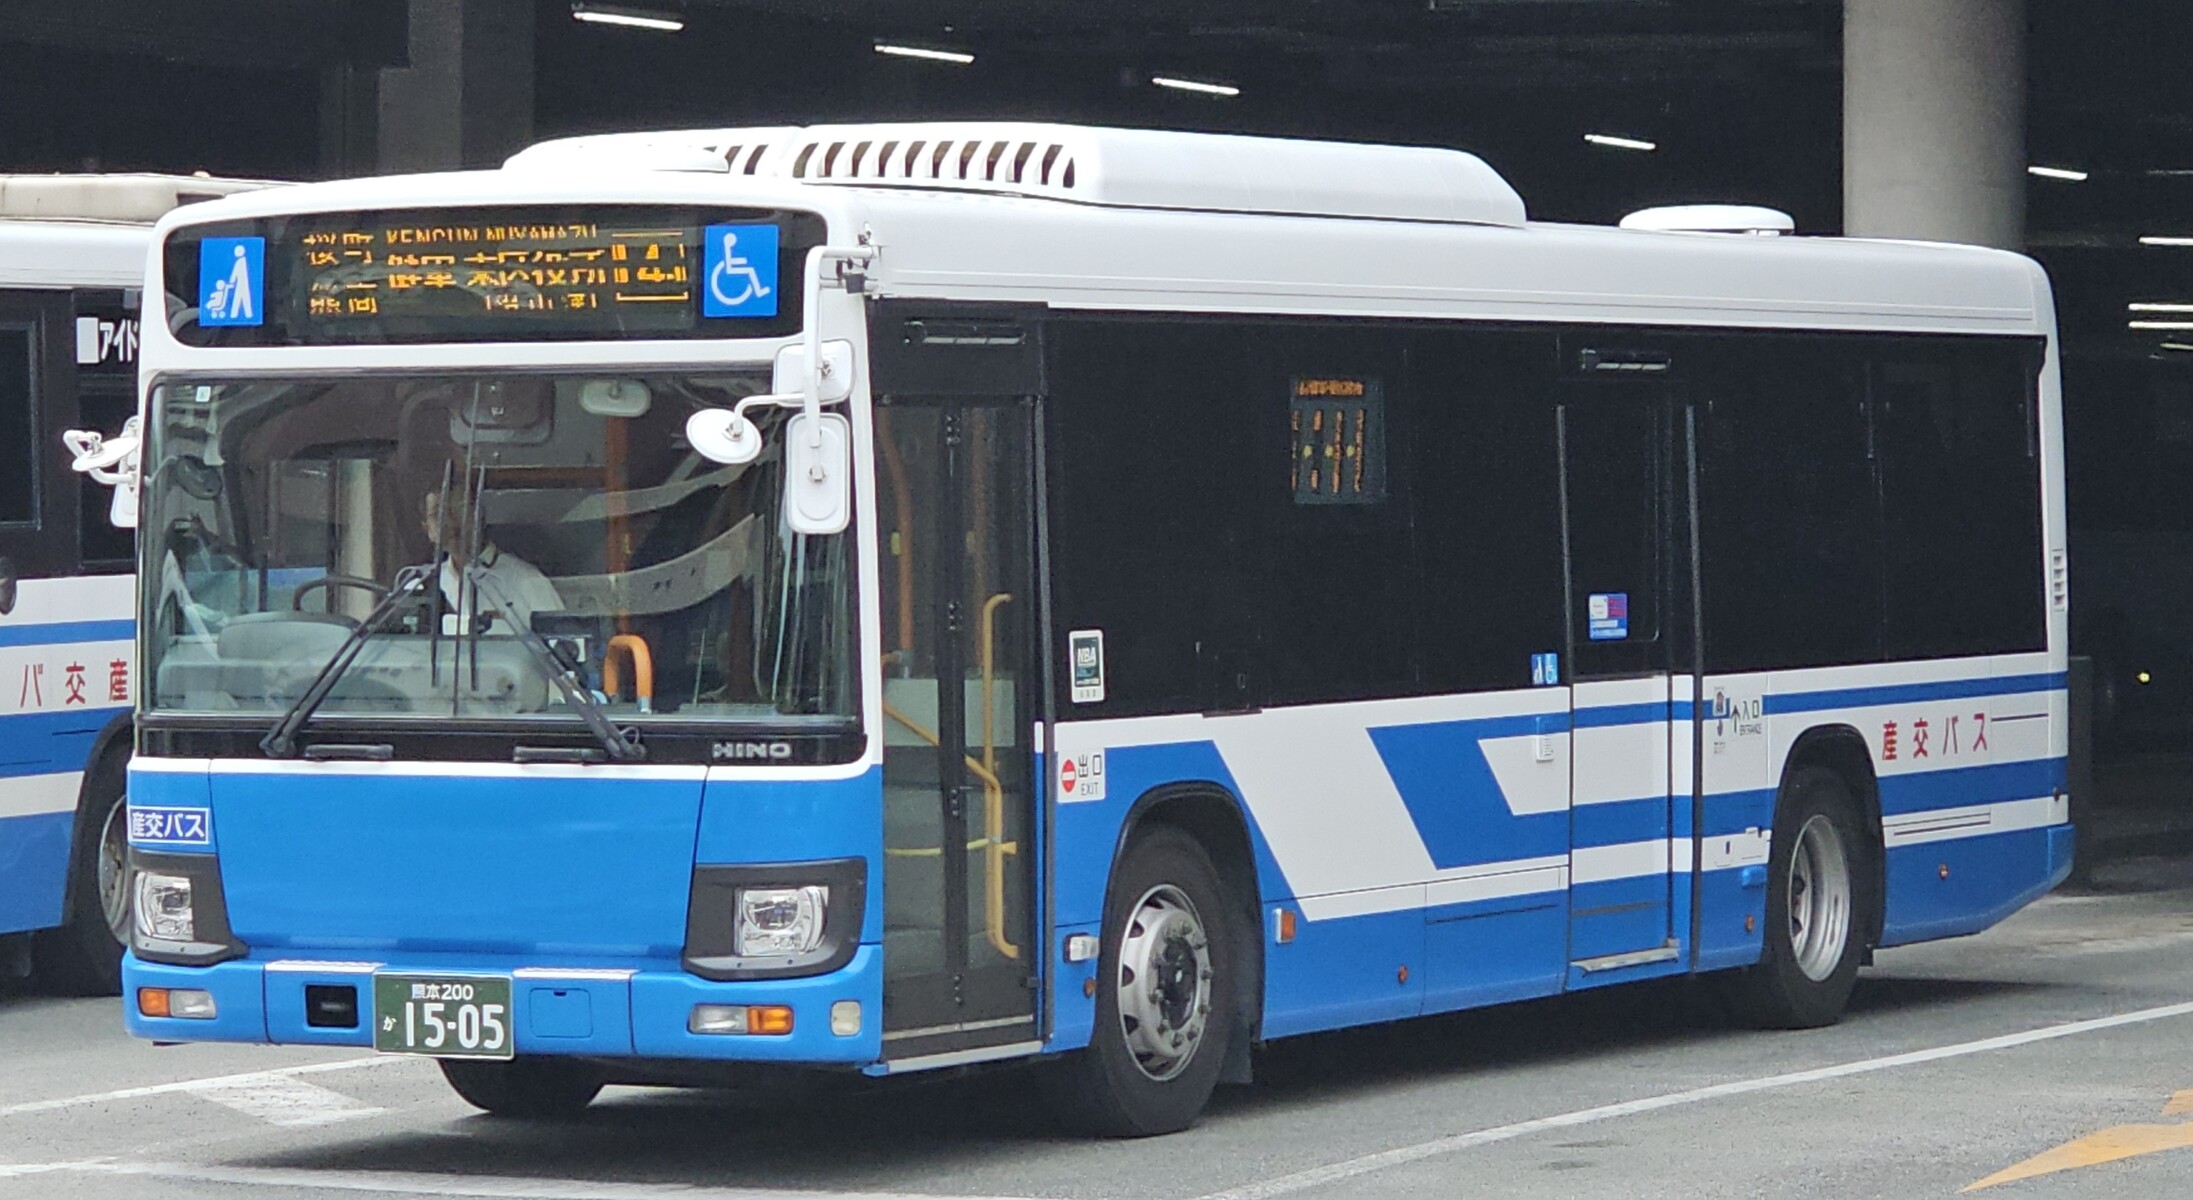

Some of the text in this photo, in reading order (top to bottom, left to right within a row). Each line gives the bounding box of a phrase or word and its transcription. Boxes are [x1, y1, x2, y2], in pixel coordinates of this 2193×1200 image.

[1882, 712, 1988, 761] 産交バス
[712, 741, 793, 759] HINO
[1078, 754, 1102, 778] 出口
[1080, 781, 1099, 797] EXIT
[131, 810, 206, 839] 産交バス
[382, 1001, 506, 1050] か 15-05
